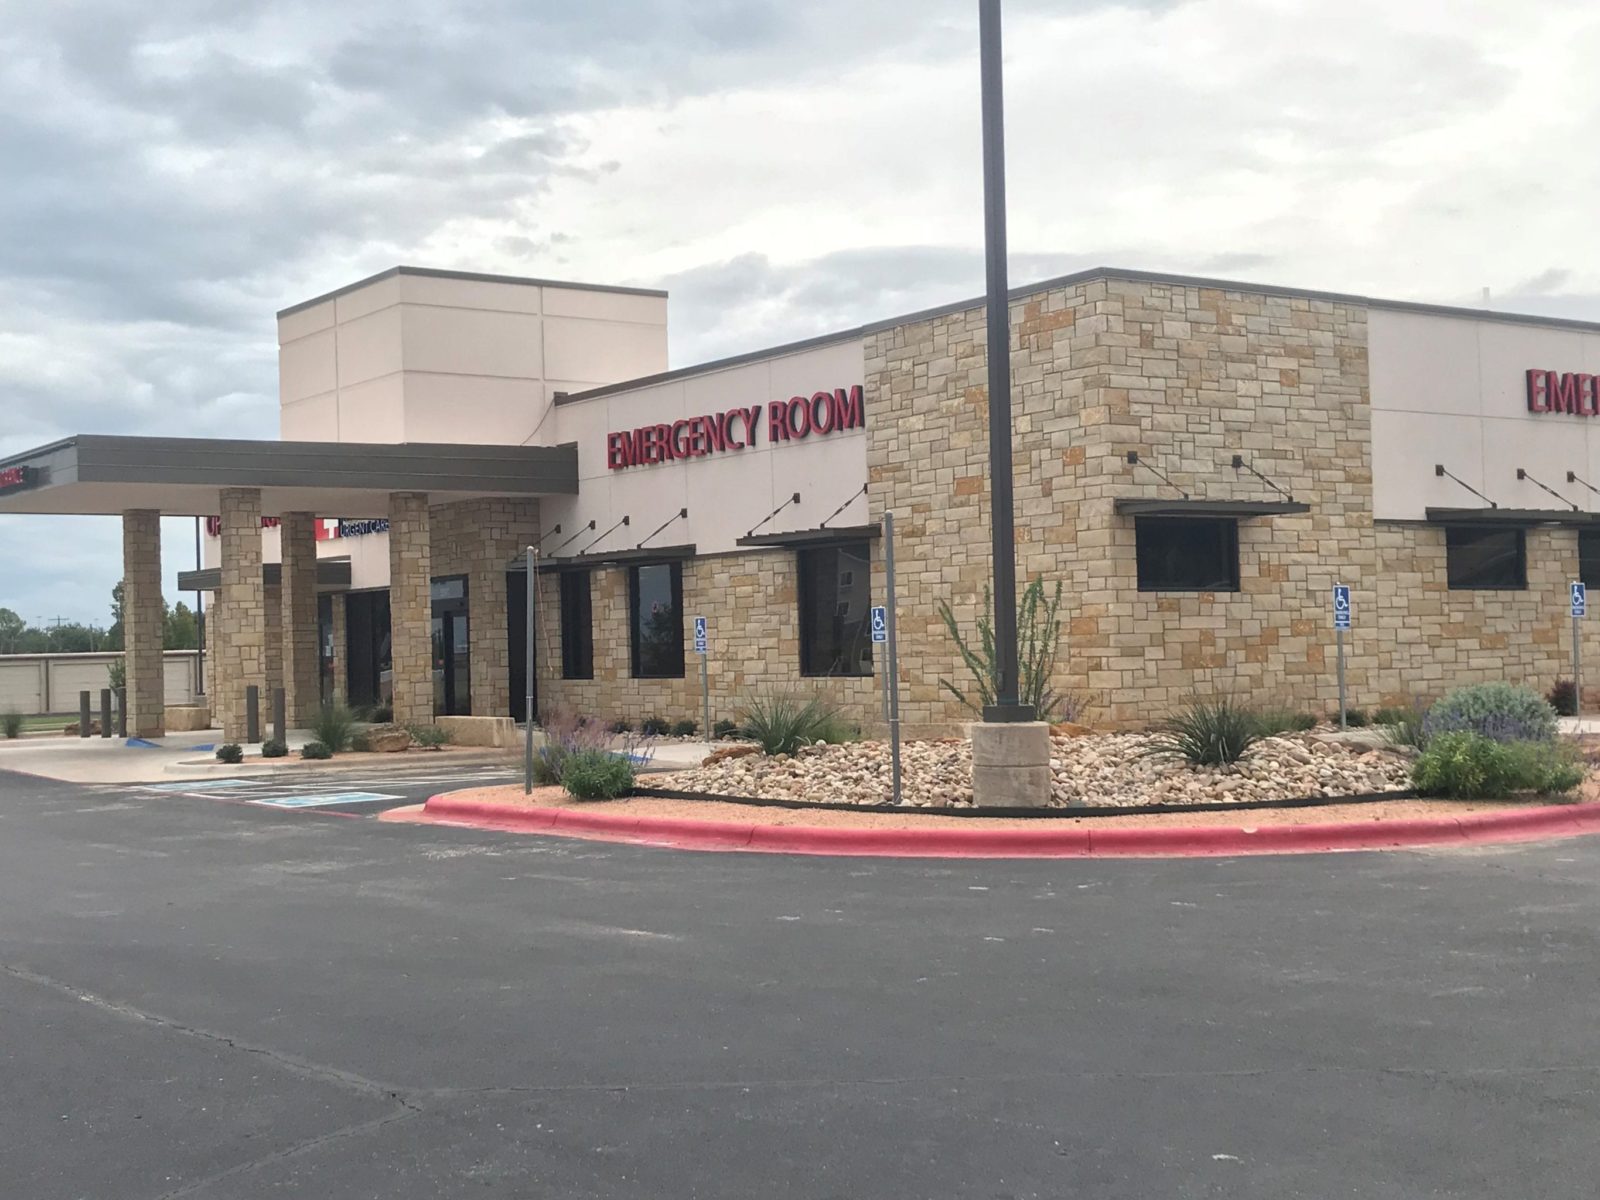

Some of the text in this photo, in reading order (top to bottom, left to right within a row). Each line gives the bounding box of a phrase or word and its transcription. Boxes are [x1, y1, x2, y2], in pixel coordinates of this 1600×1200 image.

[1525, 368, 1600, 417] EME
[607, 384, 865, 469] EMERGENCY ROOM
[340, 520, 369, 538] URGENT
